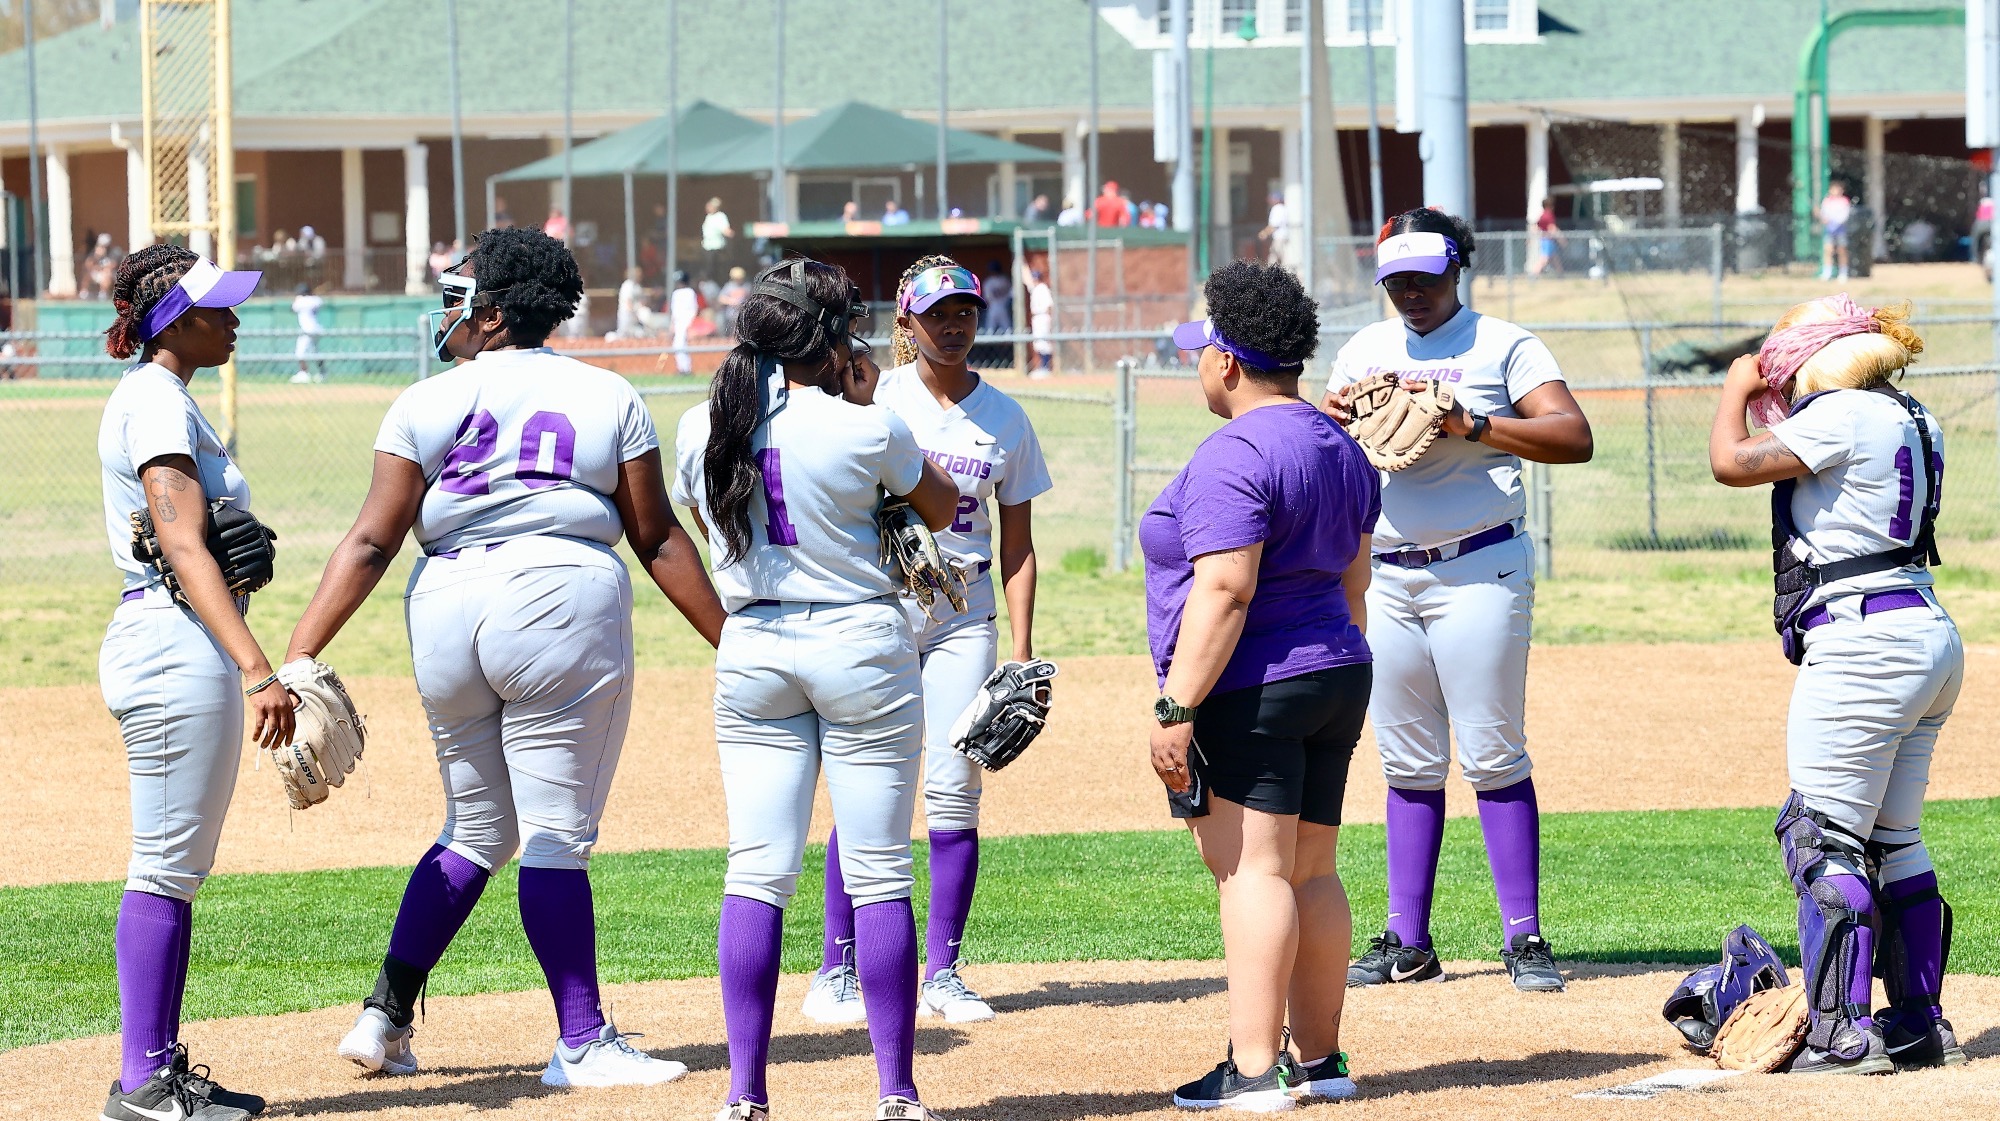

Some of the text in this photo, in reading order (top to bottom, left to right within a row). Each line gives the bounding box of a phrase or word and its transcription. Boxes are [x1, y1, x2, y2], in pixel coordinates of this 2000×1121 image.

[1364, 366, 1464, 384] Micians
[438, 408, 577, 496] 20
[753, 448, 799, 547] 1
[292, 744, 317, 785] EASTON
[884, 1104, 909, 1118] NIKE
